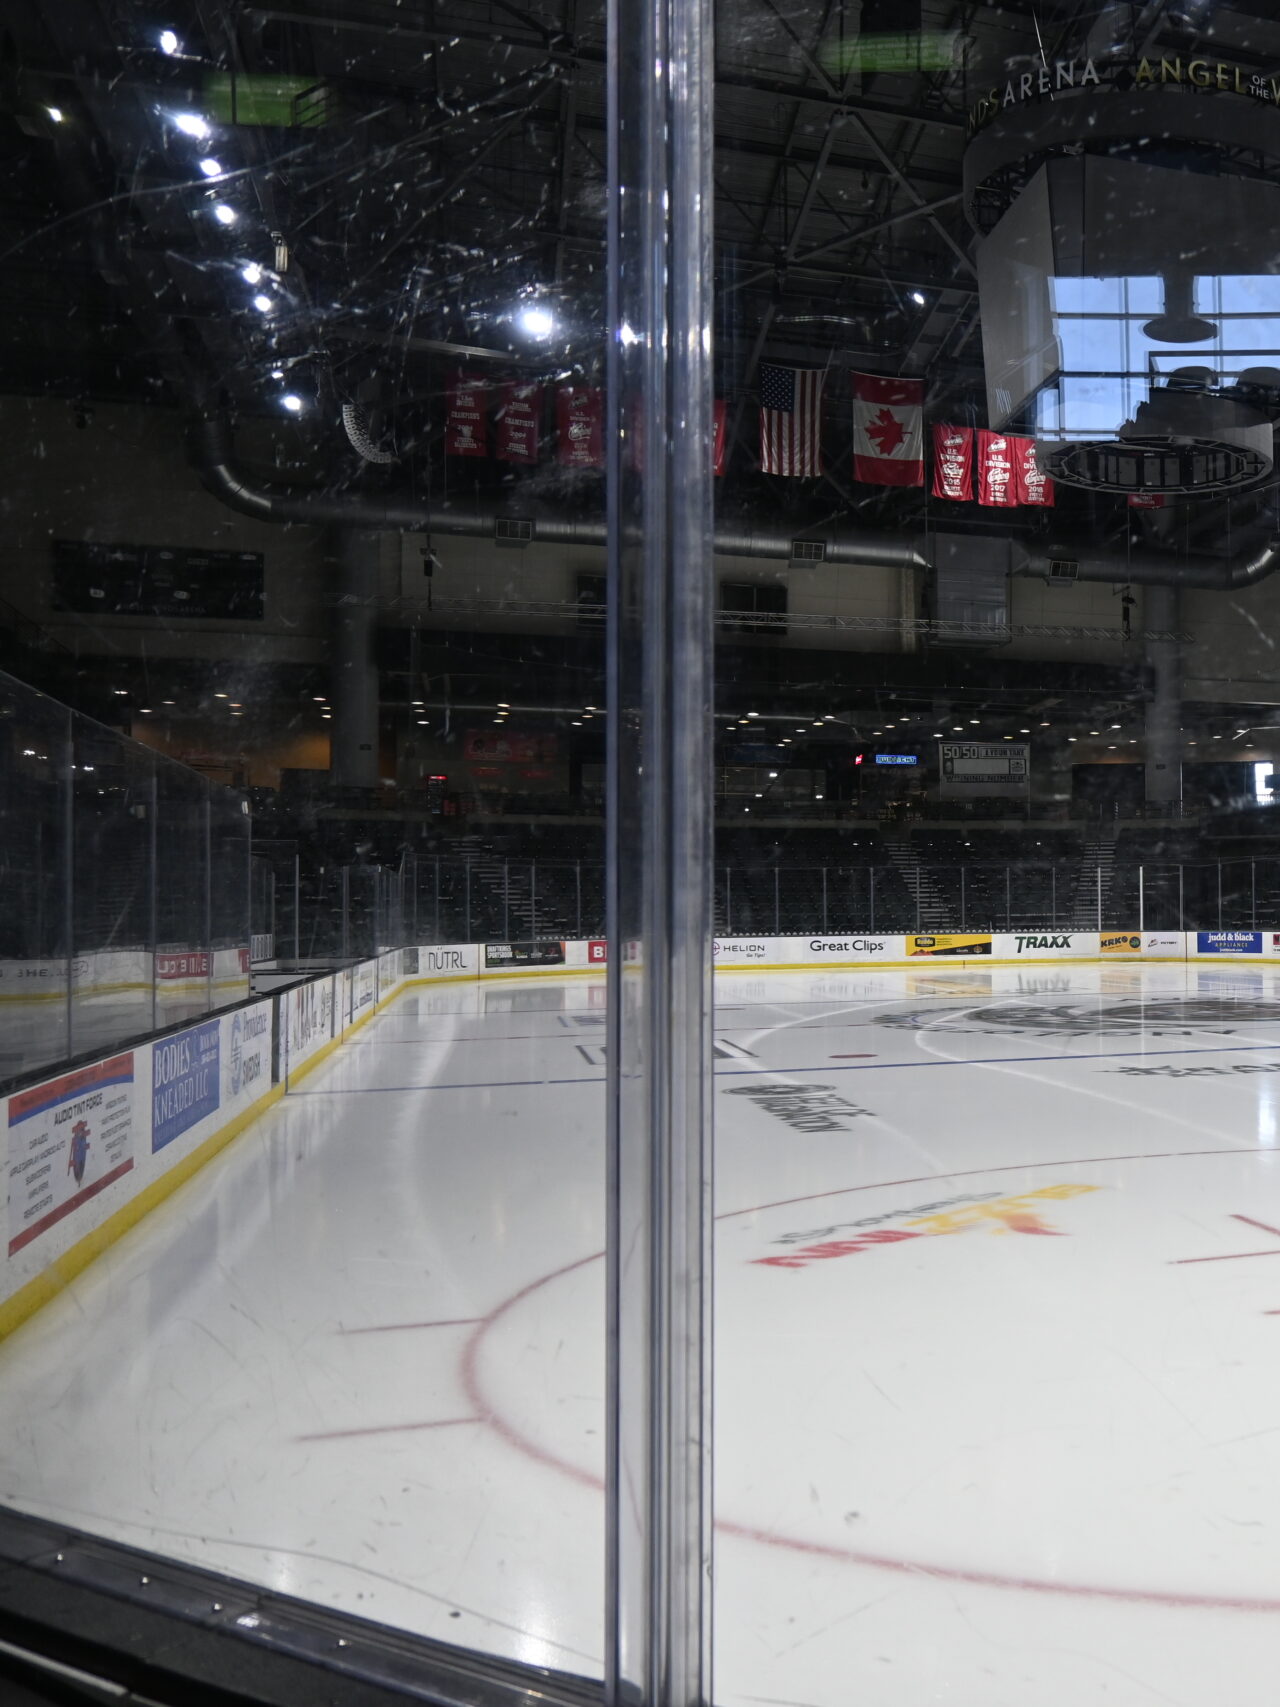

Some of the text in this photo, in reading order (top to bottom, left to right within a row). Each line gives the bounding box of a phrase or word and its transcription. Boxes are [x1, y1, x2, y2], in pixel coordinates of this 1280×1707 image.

[1002, 57, 1100, 107] ARENA
[1136, 56, 1248, 93] ANGEL
[1252, 75, 1266, 85] OF
[1249, 84, 1269, 99] THE
[810, 939, 884, 953] Great Clips
[1014, 934, 1073, 953] TRAXX
[1208, 932, 1254, 943] judd & black
[155, 1037, 190, 1089] BODIES
[54, 1104, 72, 1126] AUDIO
[73, 1099, 86, 1119] TINT
[86, 1092, 103, 1112] FORCE
[155, 1077, 194, 1128] KNEADED
[194, 1068, 208, 1103] LLC
